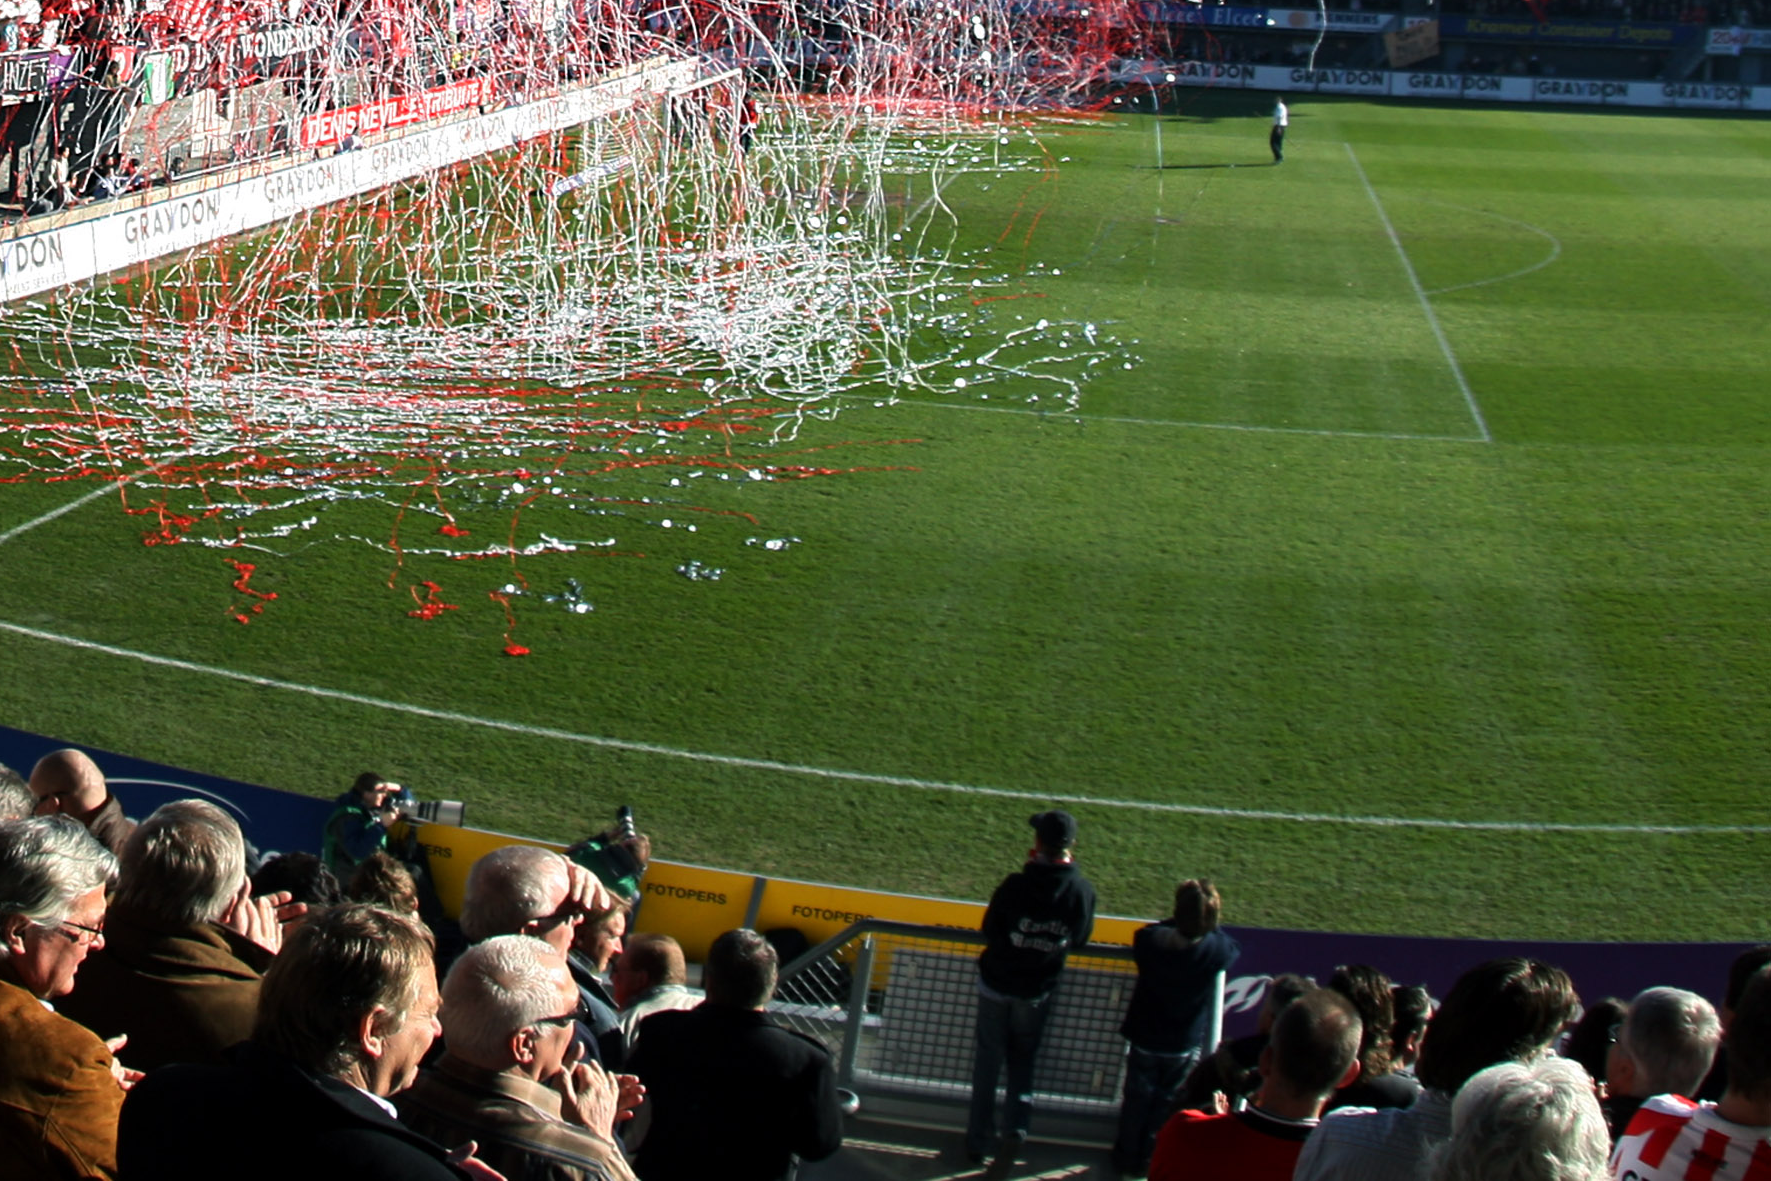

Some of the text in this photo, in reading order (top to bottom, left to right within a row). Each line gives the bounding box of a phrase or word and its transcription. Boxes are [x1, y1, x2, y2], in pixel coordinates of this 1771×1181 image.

[1538, 21, 1615, 38] Container
[1172, 63, 1256, 81] RAYDON
[1290, 69, 1384, 86] GRAYDON
[1409, 73, 1503, 91] GRAYDON
[1538, 79, 1628, 98] GRAYDON
[1663, 82, 1753, 101] GRAYDON
[307, 109, 357, 145] DENIS
[264, 164, 335, 203] GRAYDON
[124, 195, 220, 244] GRAYDON
[645, 883, 728, 906] FOTOPERS
